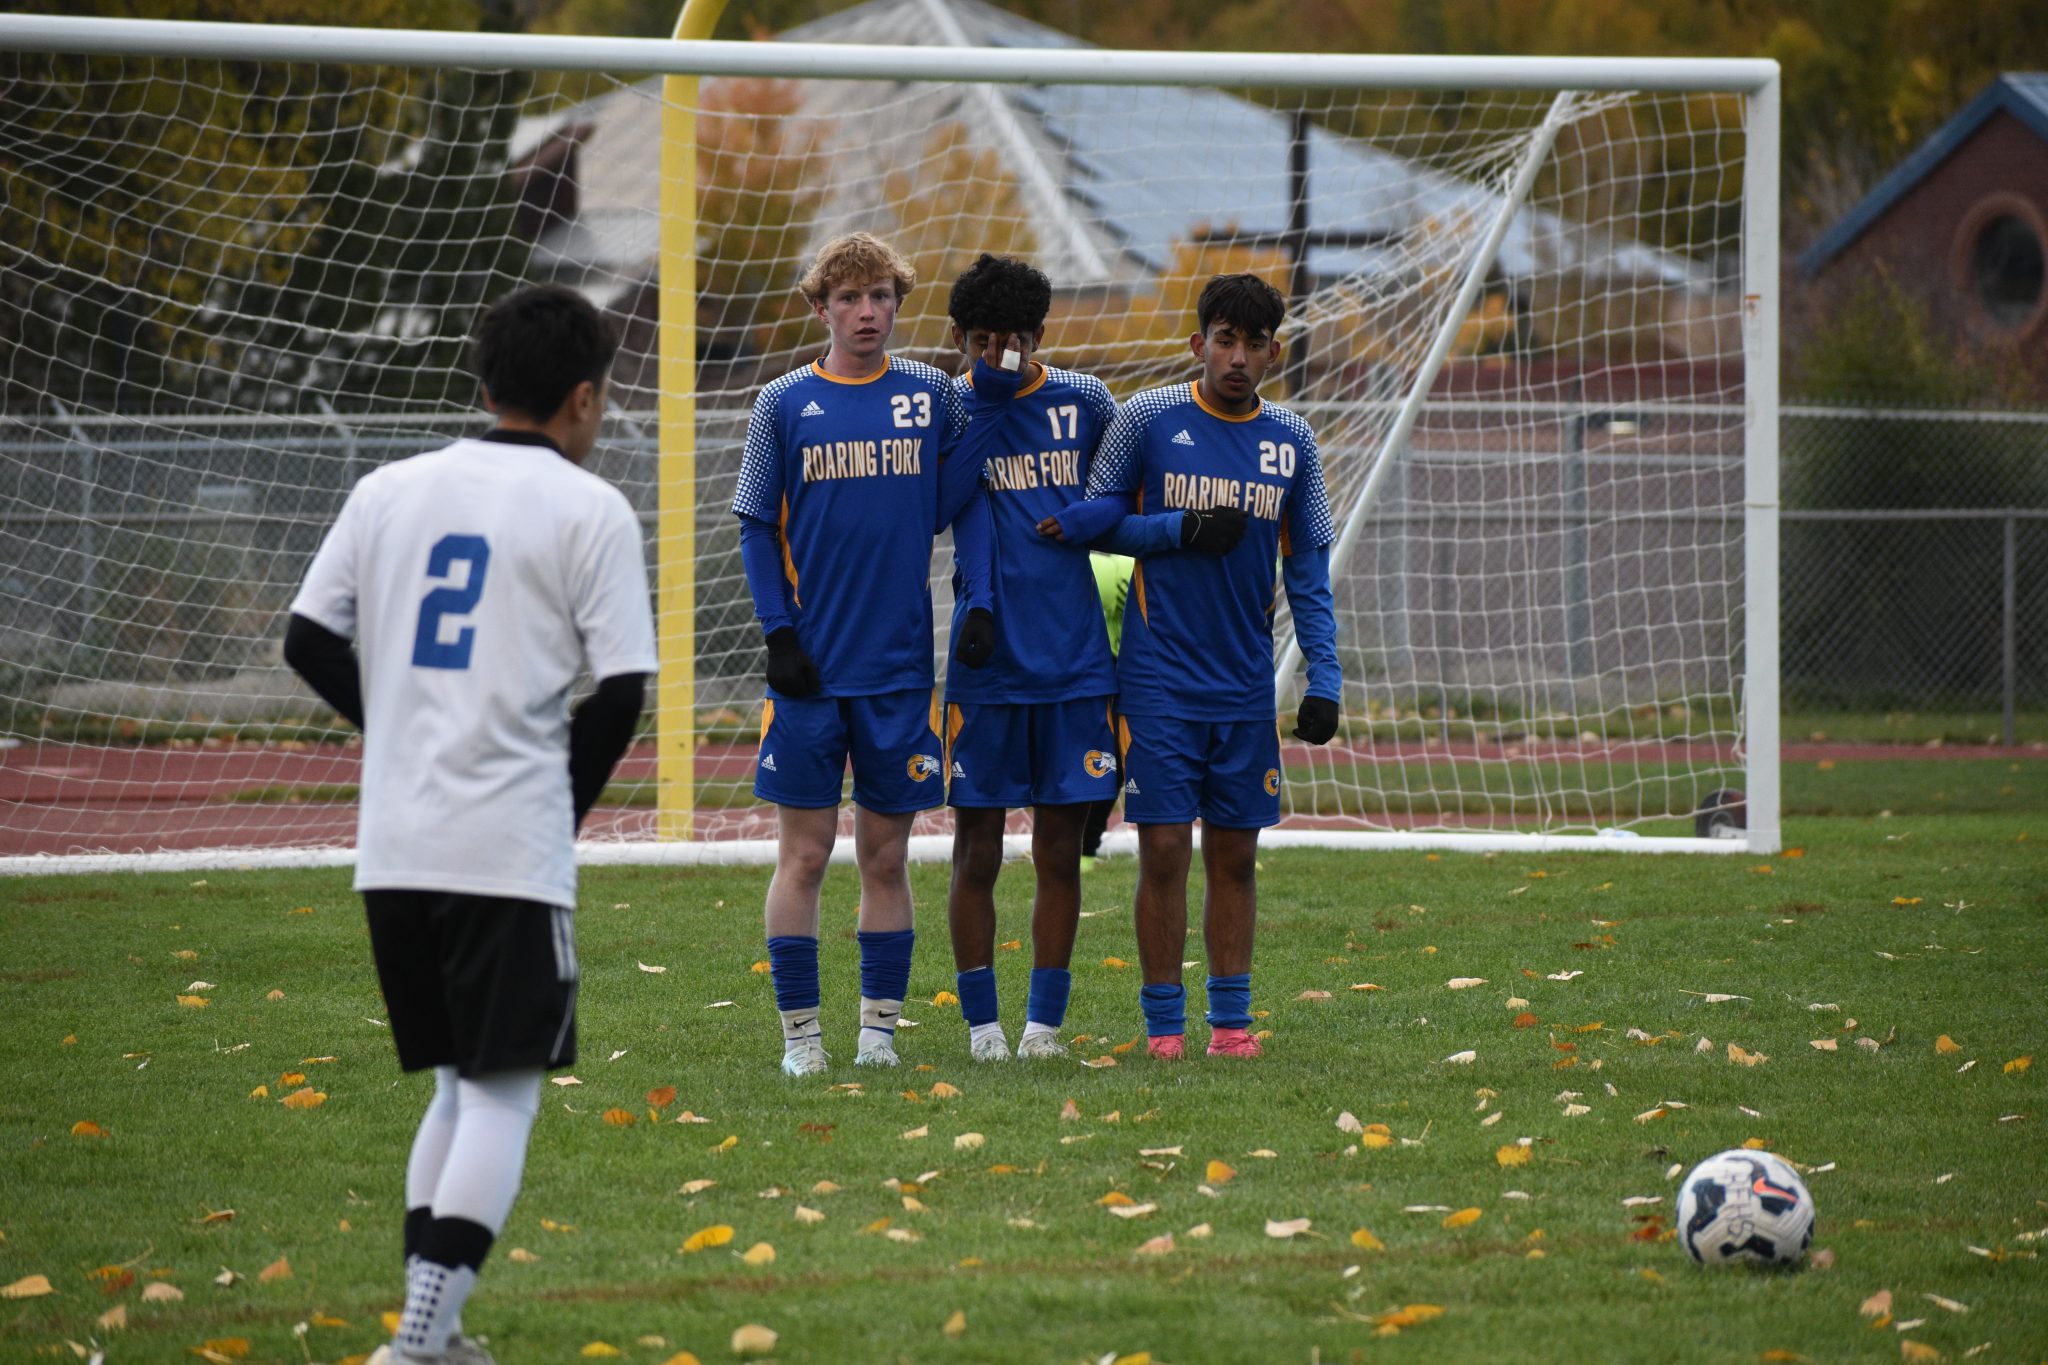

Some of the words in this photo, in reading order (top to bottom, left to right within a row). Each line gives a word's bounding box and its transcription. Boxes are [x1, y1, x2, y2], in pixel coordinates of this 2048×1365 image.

[890, 391, 931, 428] 23
[1046, 404, 1078, 440] 17
[802, 440, 878, 483] ROARING
[881, 438, 922, 476] FORK
[986, 454, 1038, 491] ARING
[1040, 449, 1080, 487] FORK
[1259, 440, 1296, 478] 20
[1164, 472, 1240, 511] ROARING
[1243, 481, 1285, 521] FORK
[411, 531, 491, 671] 2
